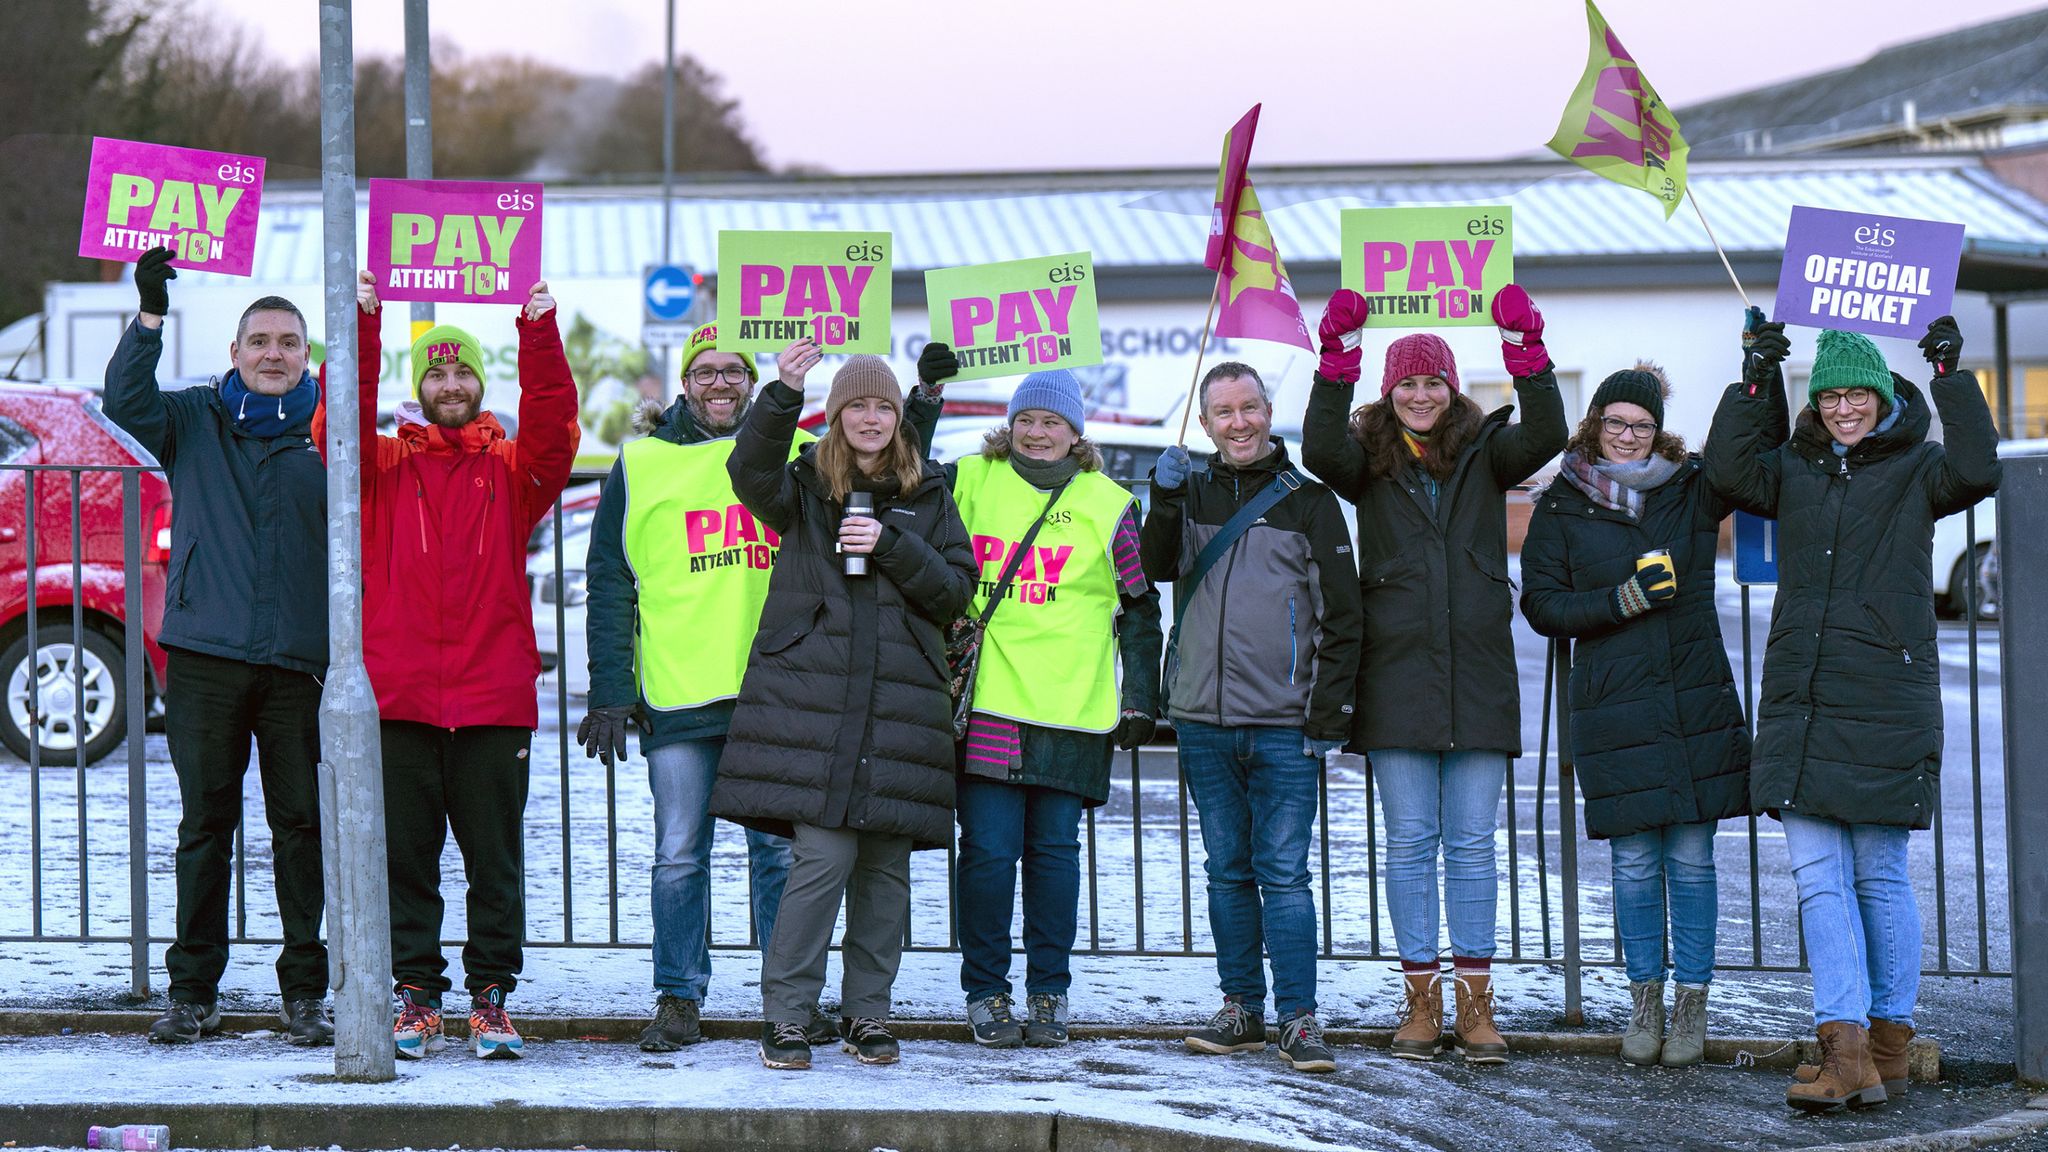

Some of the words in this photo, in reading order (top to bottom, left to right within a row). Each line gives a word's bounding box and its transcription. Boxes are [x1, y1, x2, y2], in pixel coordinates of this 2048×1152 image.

[217, 161, 256, 184] eis
[107, 173, 244, 237] PAY
[496, 189, 535, 211] eis
[390, 213, 525, 268] PAY
[1466, 215, 1504, 236] eis
[1854, 223, 1896, 247] eis
[845, 240, 884, 262] eis
[1364, 240, 1496, 292] PAY
[1048, 262, 1085, 283] eis
[1804, 254, 1931, 296] OFFICIAL
[740, 264, 875, 318] PAY
[1810, 286, 1918, 325] PICKET
[950, 285, 1078, 348] PAY
[427, 342, 462, 360] PAY
[1100, 326, 1240, 356] SCHOOL
[972, 534, 1075, 584] PAY
